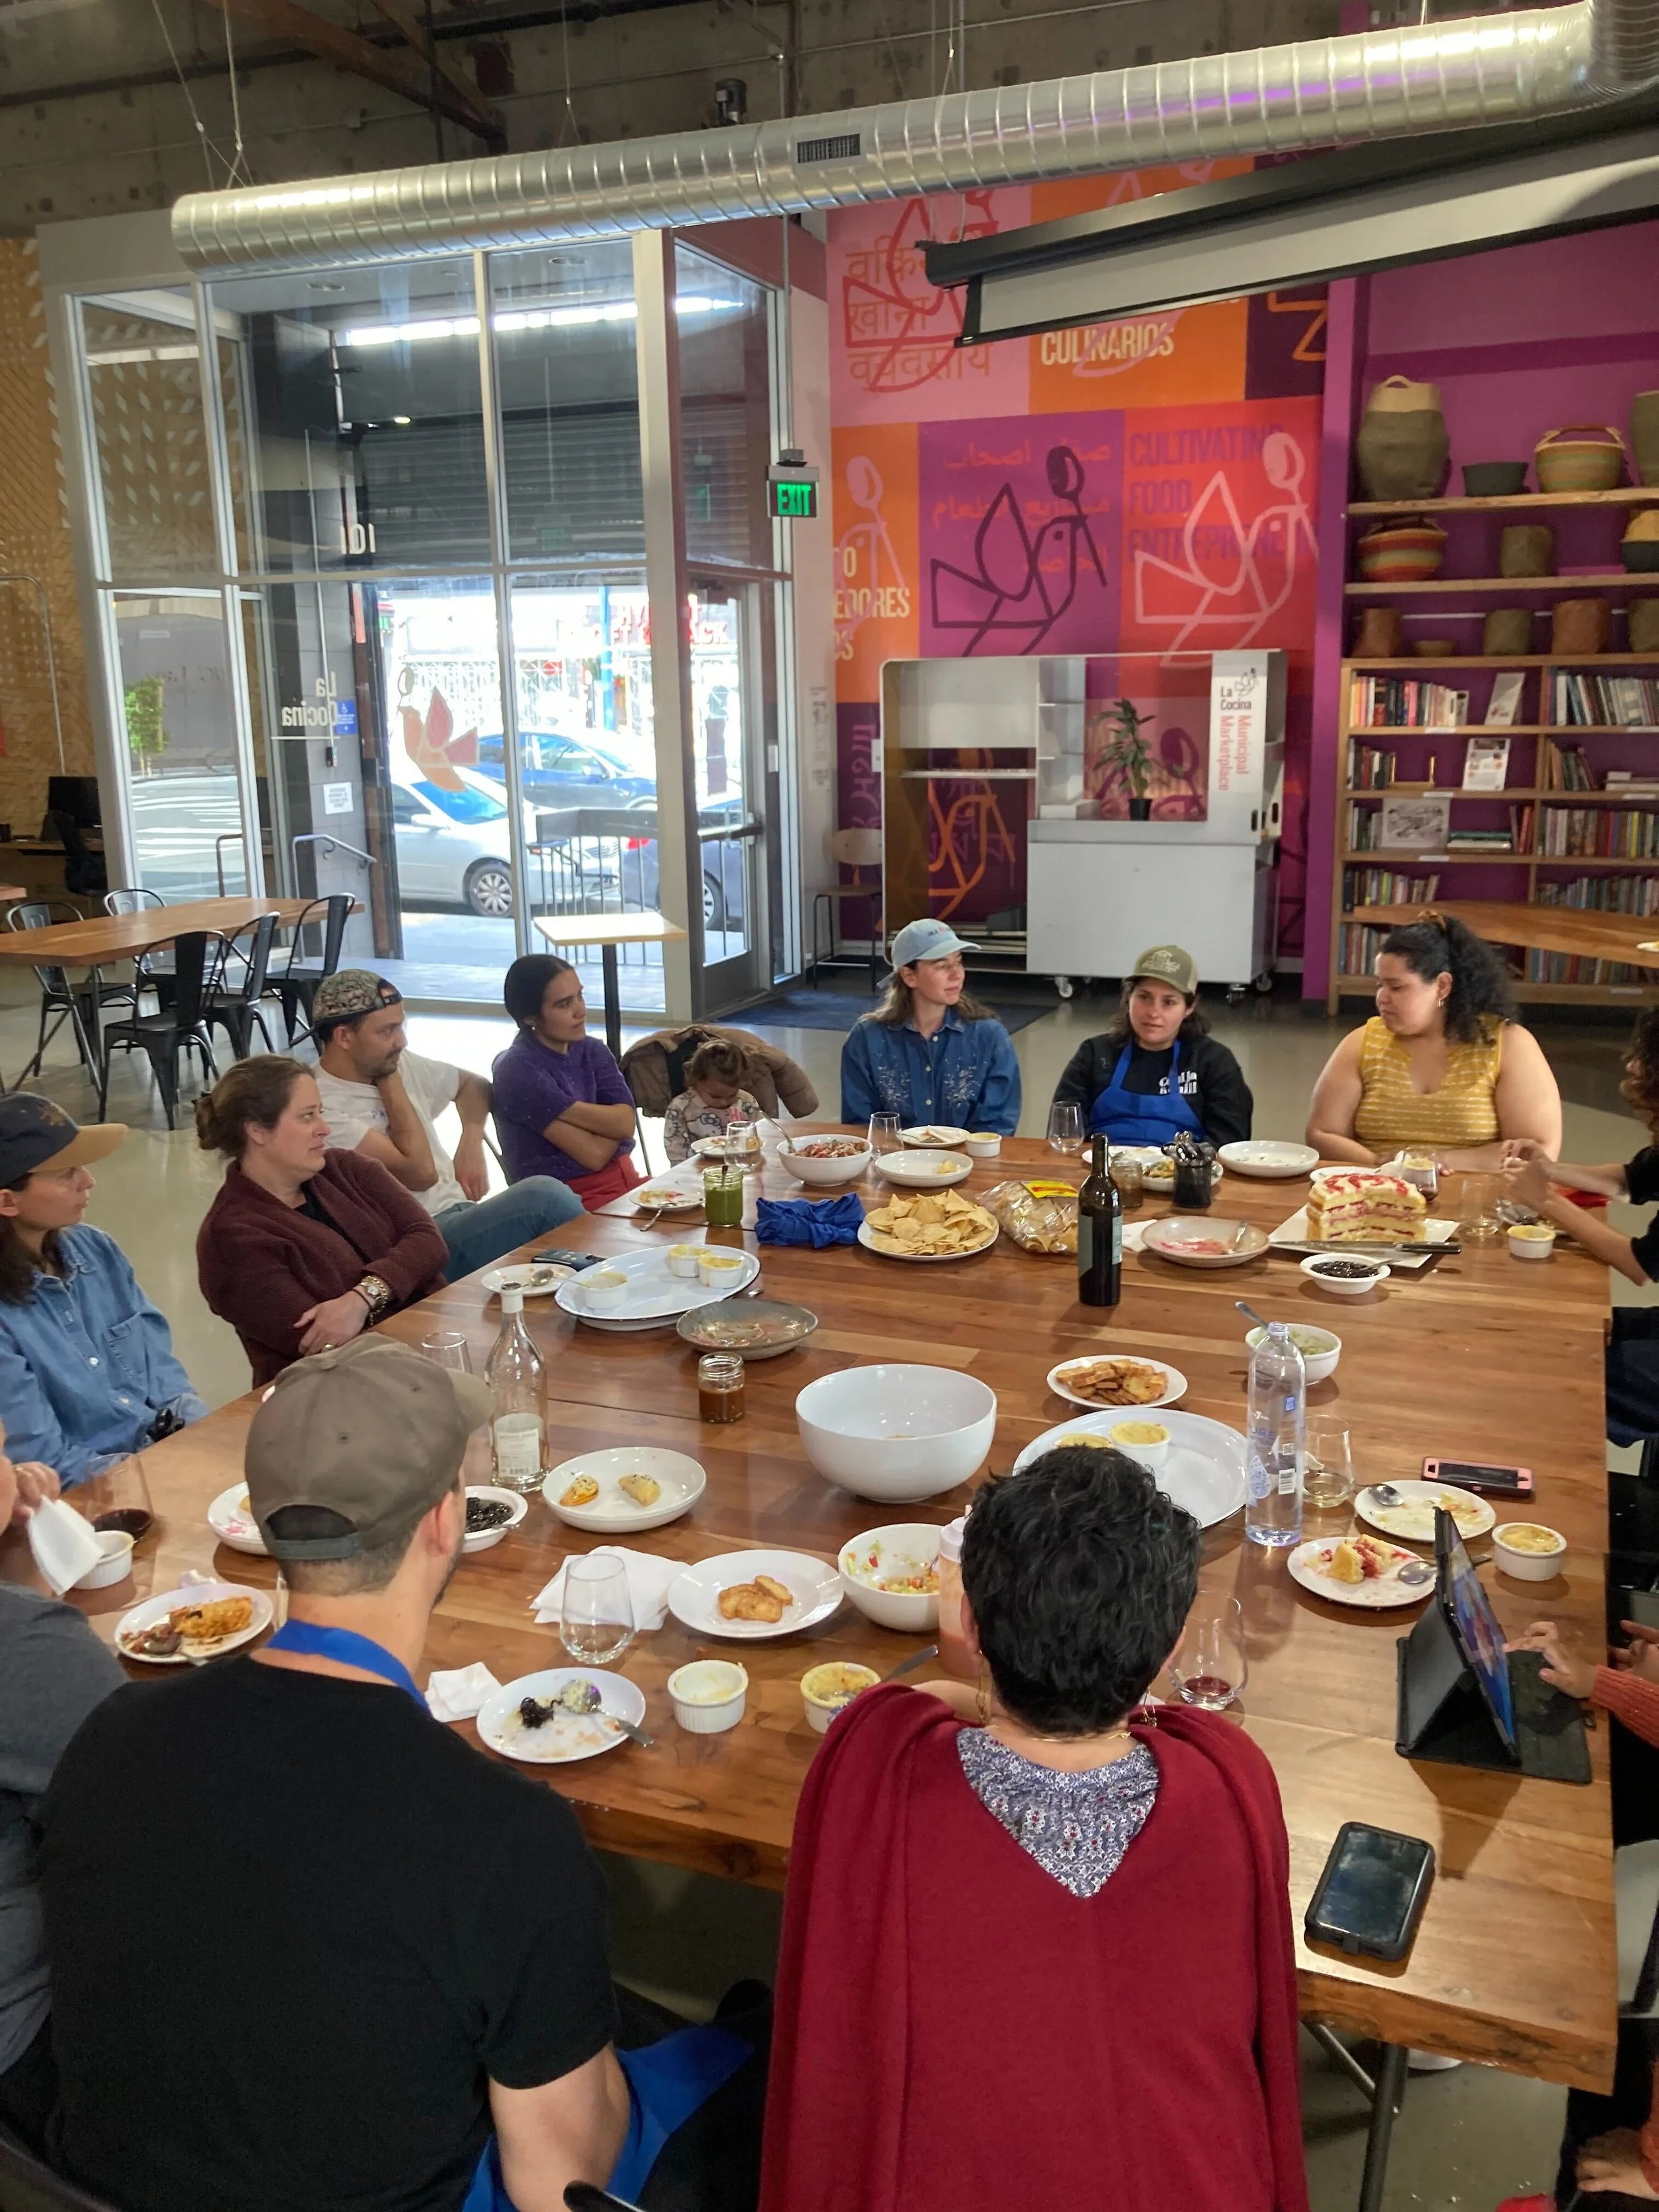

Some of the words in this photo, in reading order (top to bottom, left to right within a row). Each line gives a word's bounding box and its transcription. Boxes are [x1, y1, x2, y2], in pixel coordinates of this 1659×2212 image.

[1041, 321, 1175, 366] CULINARIOS
[776, 483, 812, 516] EXIT
[1128, 477, 1192, 516] FOOD
[1220, 686, 1232, 698] La
[1220, 699, 1252, 711] Cocina
[1217, 715, 1234, 791] Marketplace
[1236, 715, 1253, 776] Municipal
